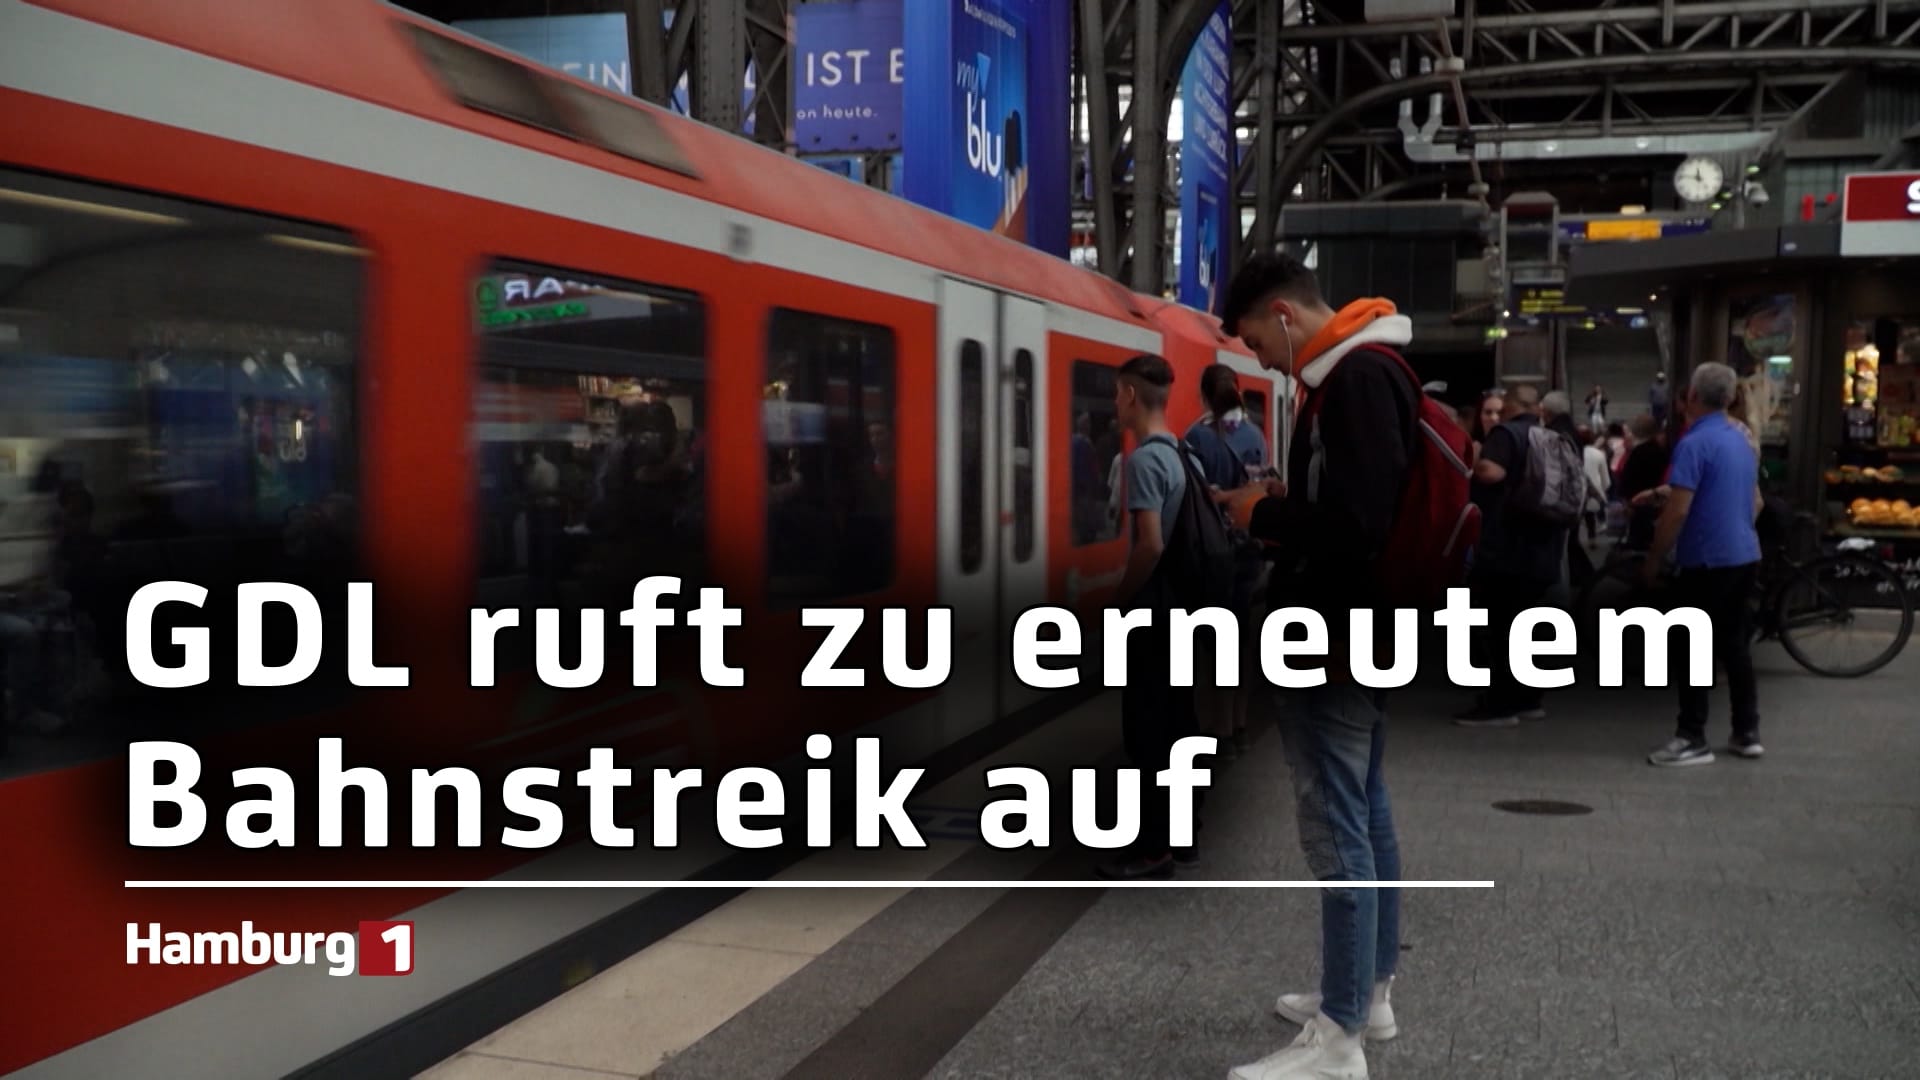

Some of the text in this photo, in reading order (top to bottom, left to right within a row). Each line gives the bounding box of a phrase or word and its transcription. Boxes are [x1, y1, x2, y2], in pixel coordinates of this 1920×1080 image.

[806, 49, 870, 86] IST
[957, 61, 980, 112] my
[823, 104, 878, 119] heute.
[967, 91, 1001, 178] blu
